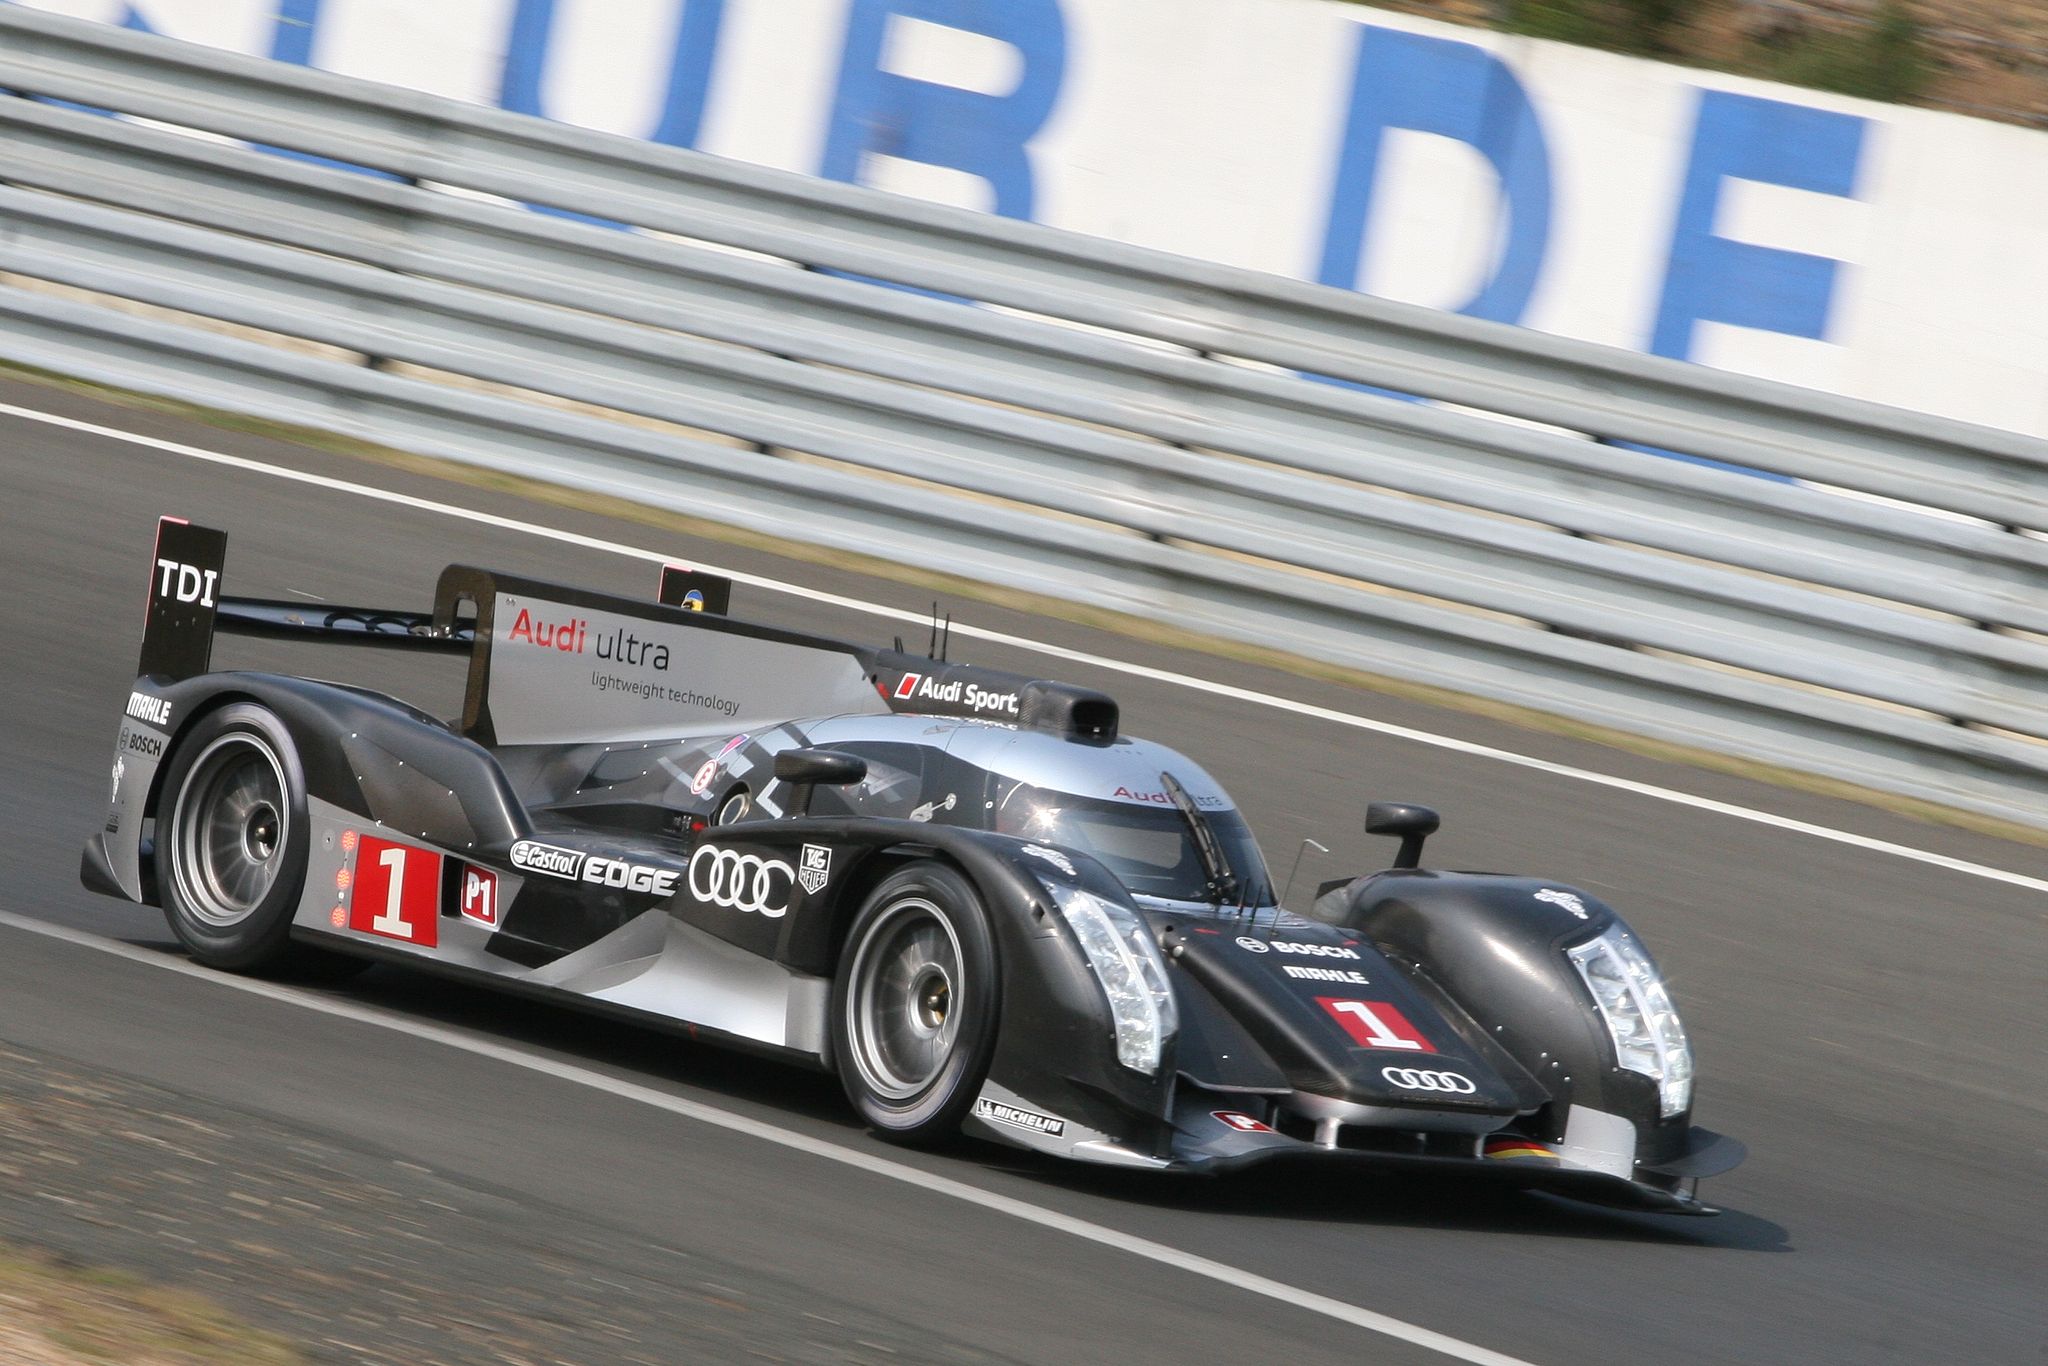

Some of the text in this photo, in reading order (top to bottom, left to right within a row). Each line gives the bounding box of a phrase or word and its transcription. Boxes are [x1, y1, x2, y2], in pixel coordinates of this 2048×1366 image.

[157, 558, 218, 608] TDI
[508, 607, 671, 671] Audi ultra
[126, 691, 172, 726] MAHLE
[591, 671, 740, 717] lightweight technology
[918, 676, 1020, 713] Audi Sport
[129, 733, 162, 757] BOSCH
[1191, 791, 1223, 807] ltra
[526, 846, 681, 897] Castrol EDGE
[806, 848, 827, 869] TAG
[372, 847, 413, 939] 1
[465, 871, 491, 917] P1
[800, 869, 826, 891] HEUER
[1270, 941, 1361, 960] BOSCH
[1282, 965, 1370, 985] MAHLE
[1332, 1001, 1423, 1050] 1
[993, 1105, 1063, 1132] MICHELIN
